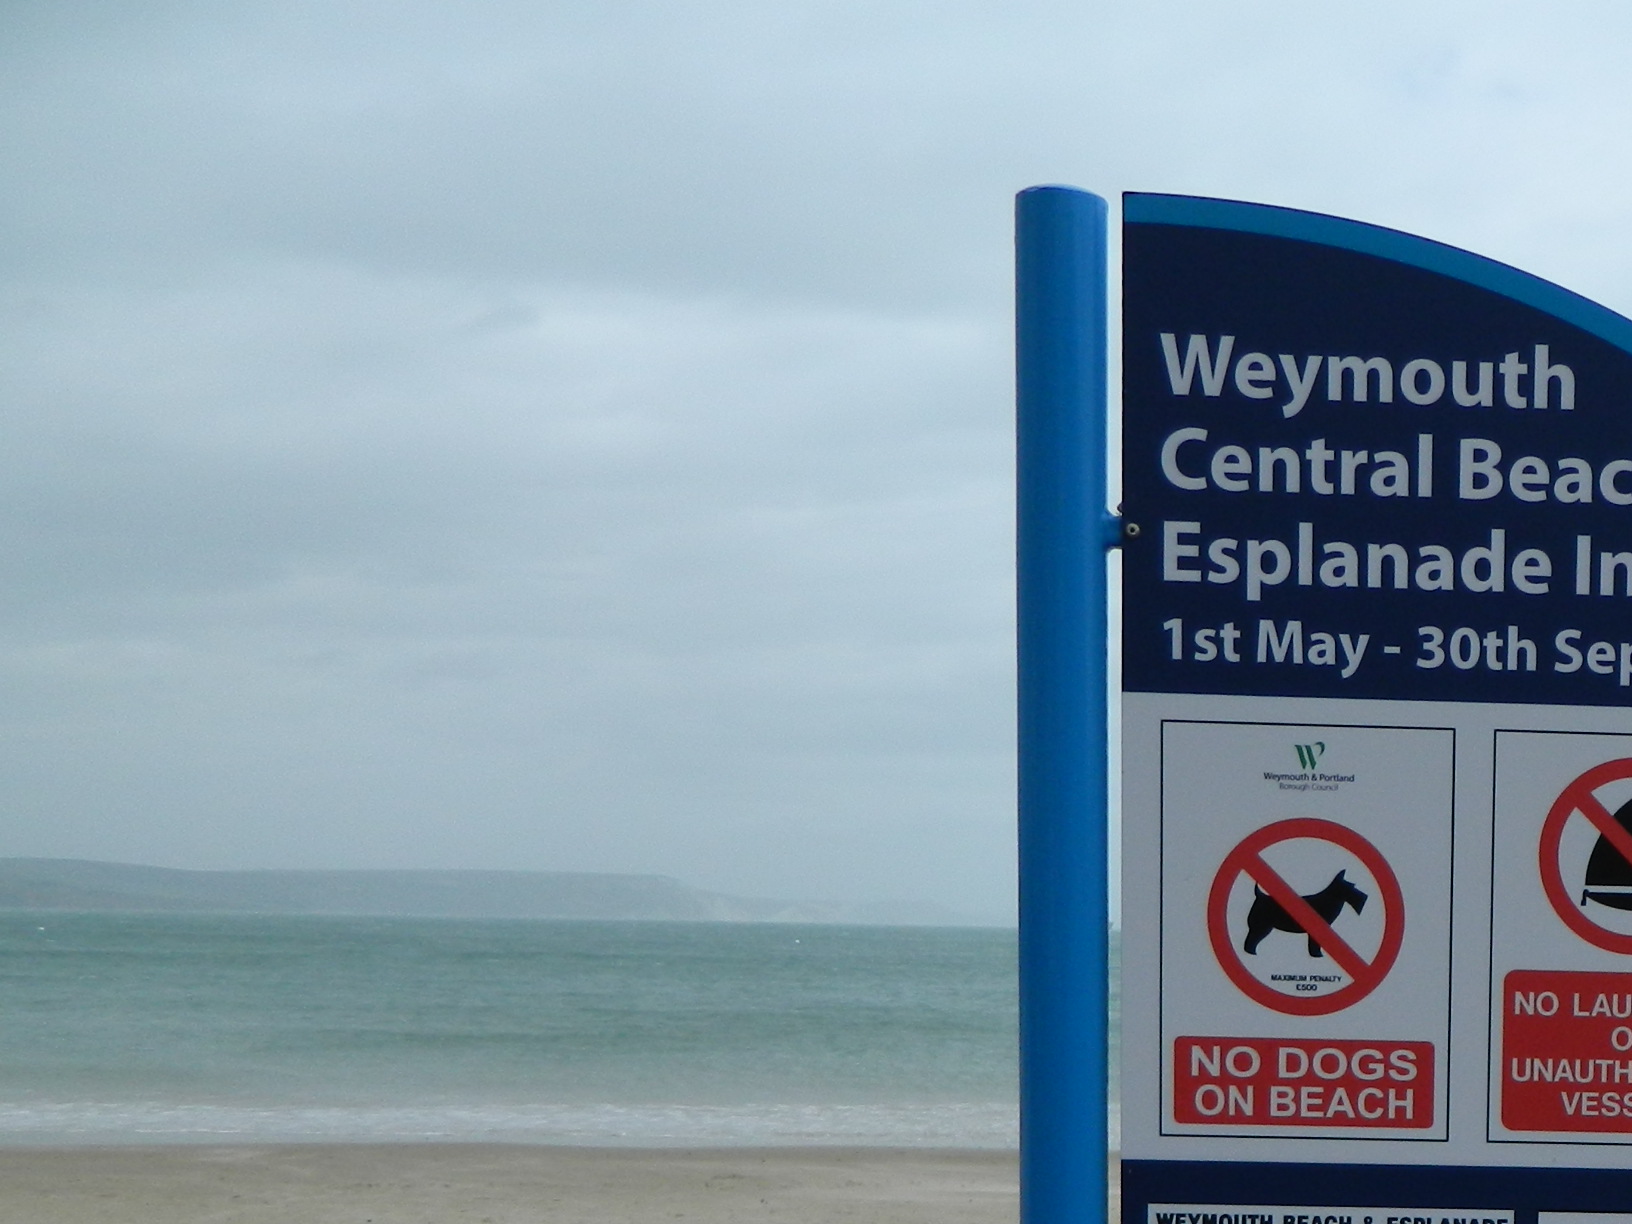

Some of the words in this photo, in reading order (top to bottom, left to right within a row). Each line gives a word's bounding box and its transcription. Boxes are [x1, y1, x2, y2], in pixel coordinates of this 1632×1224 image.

[1160, 331, 1577, 418] Weymouth
[1161, 427, 1433, 498] Central
[1163, 520, 1552, 601] Esplanade
[1163, 618, 1240, 662] 1st
[1257, 619, 1370, 678] May
[1416, 625, 1536, 671] 30th
[1263, 772, 1309, 783] Weymouth
[1311, 773, 1317, 781] &
[1319, 773, 1354, 782] Portland
[1514, 991, 1559, 1016] NO
[1191, 1045, 1260, 1078] NO
[1278, 1046, 1418, 1081] DOGS
[1194, 1084, 1253, 1116] ON
[1270, 1085, 1413, 1119] BEACH
